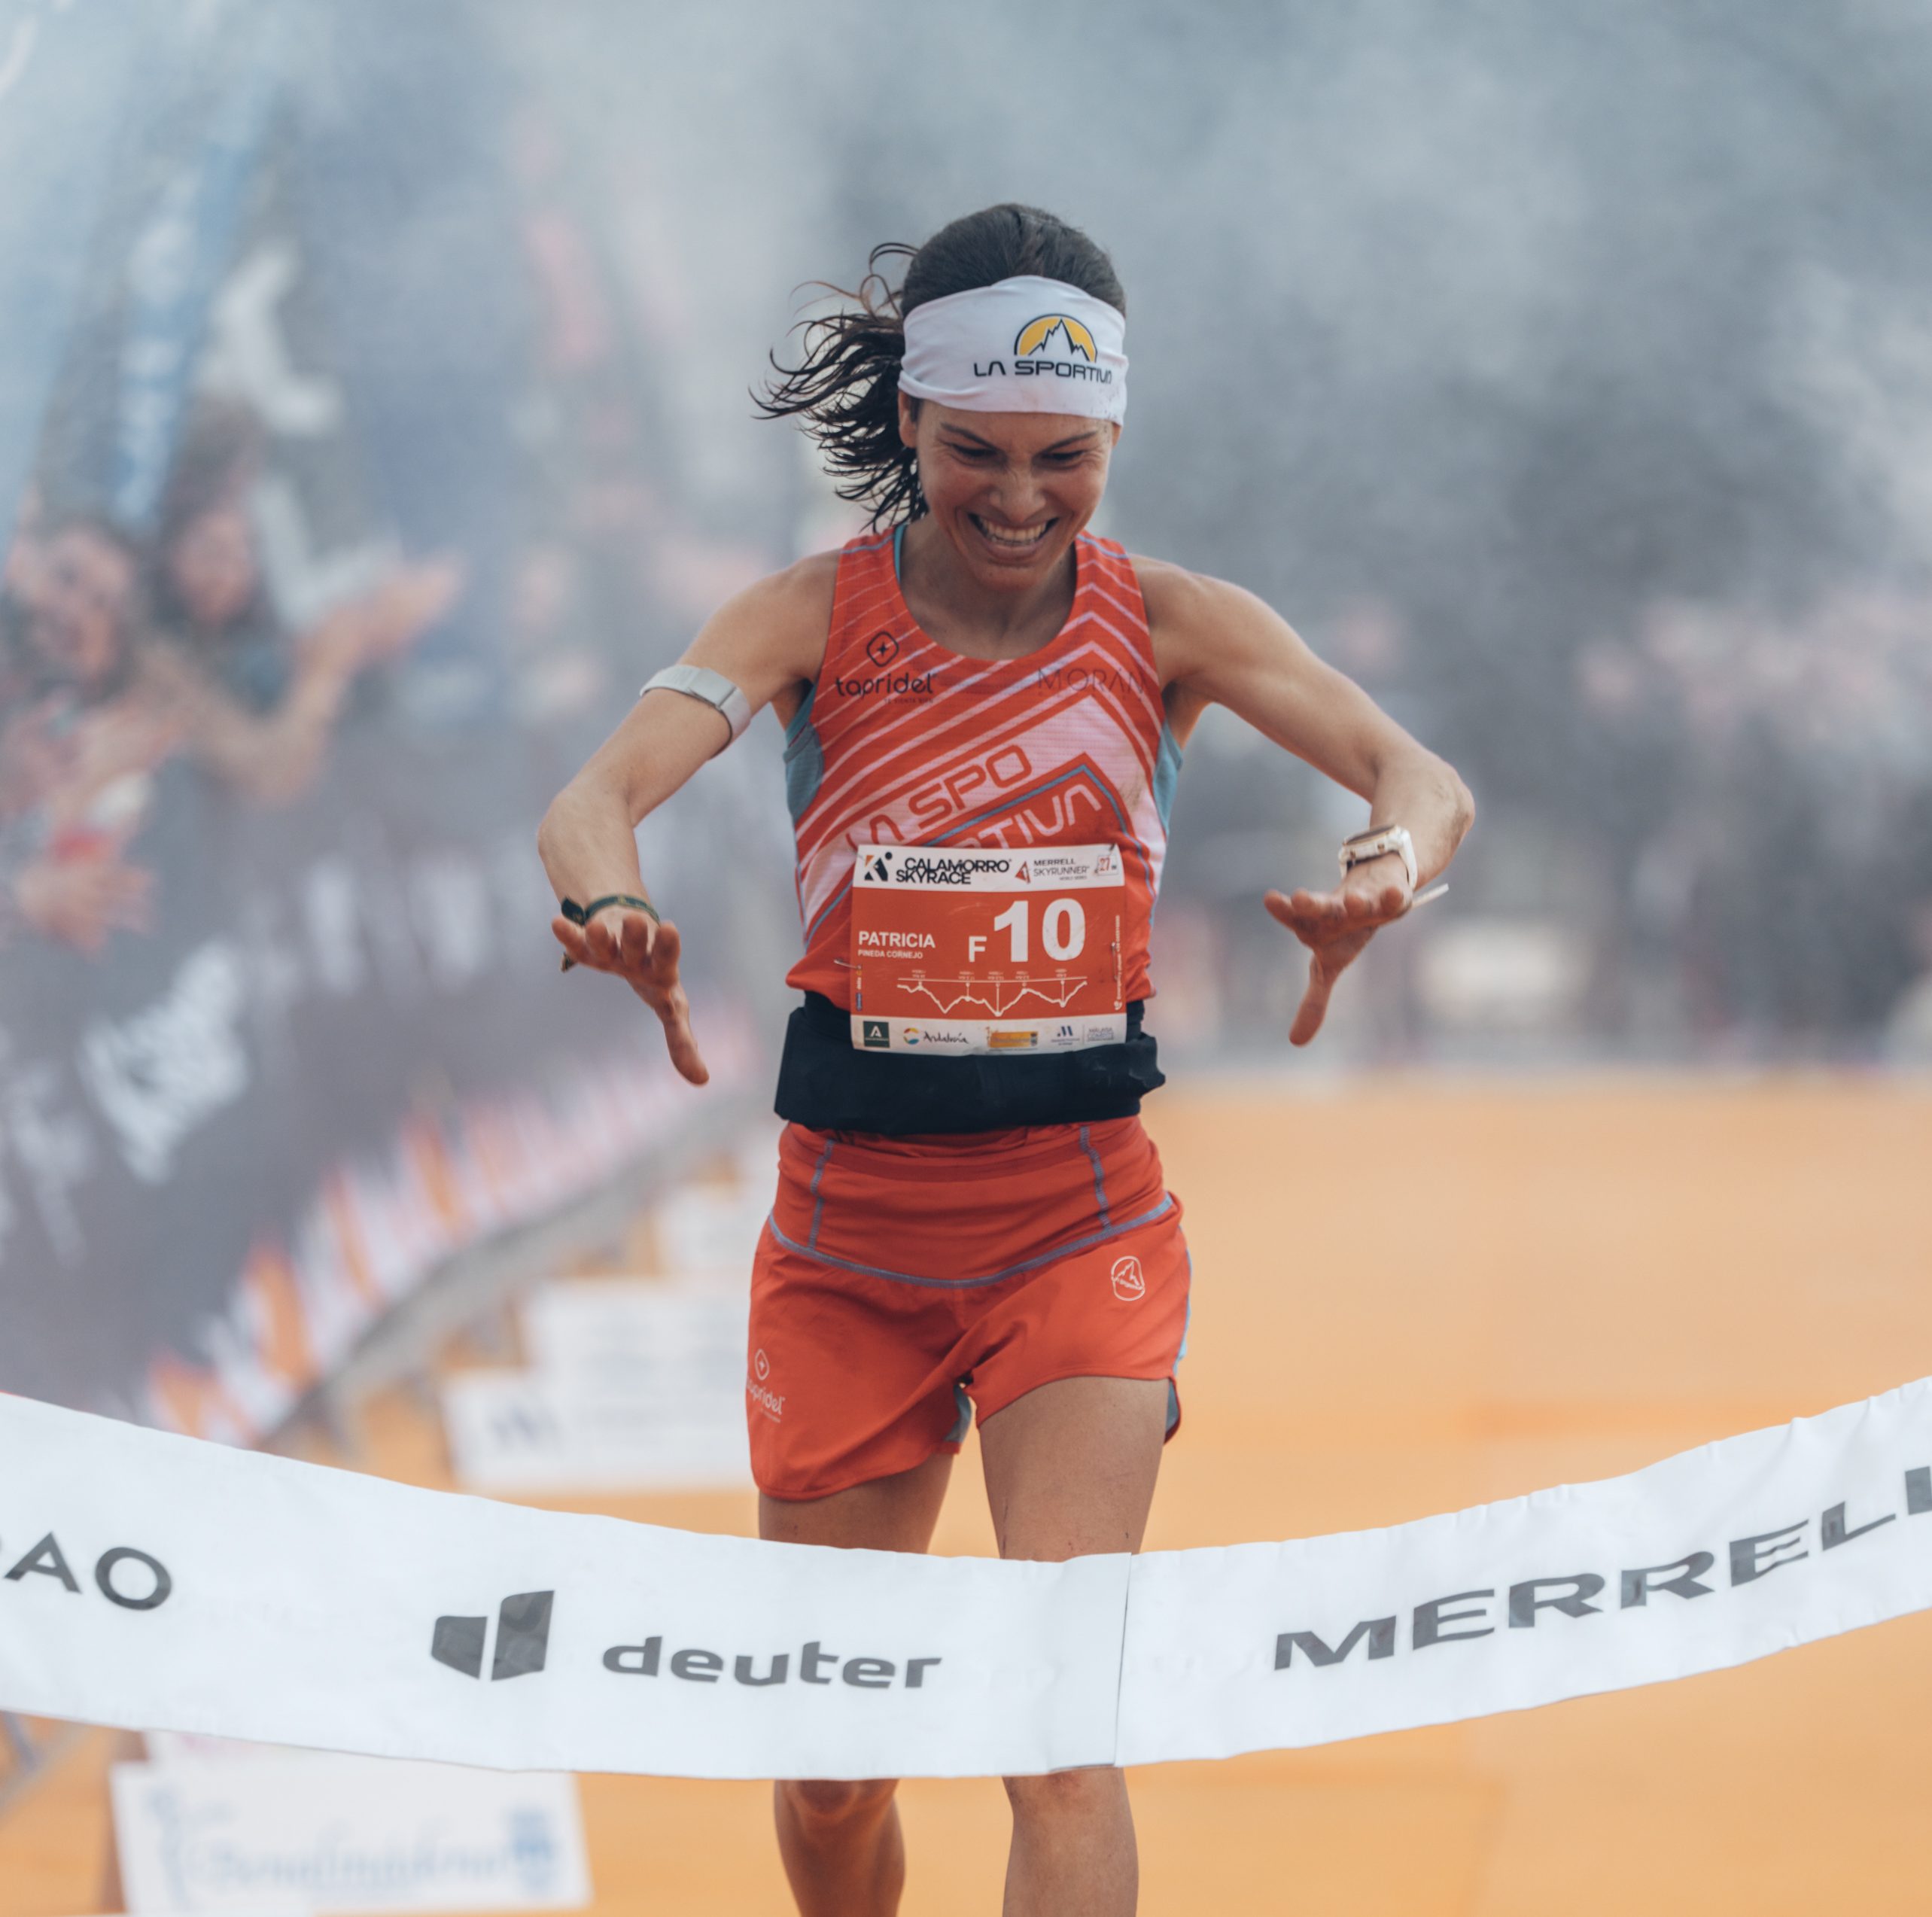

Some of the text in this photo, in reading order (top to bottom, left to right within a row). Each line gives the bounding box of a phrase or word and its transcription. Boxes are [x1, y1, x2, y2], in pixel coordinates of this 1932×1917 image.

[973, 361, 1006, 377] LA
[836, 672, 933, 699] tapridel
[908, 745, 1033, 829] SPO
[905, 857, 1010, 873] CALAMORRO
[1033, 858, 1076, 866] MERRELL
[896, 869, 972, 885] SKYRACE
[1033, 866, 1088, 877] SKYRUNNER
[858, 930, 936, 948] PATRICIA
[969, 936, 987, 963] F
[993, 898, 1086, 962] 10
[857, 949, 923, 960] PINEDA CORNEJO
[0, 1531, 172, 1611] AO
[602, 1636, 942, 1689] deuter
